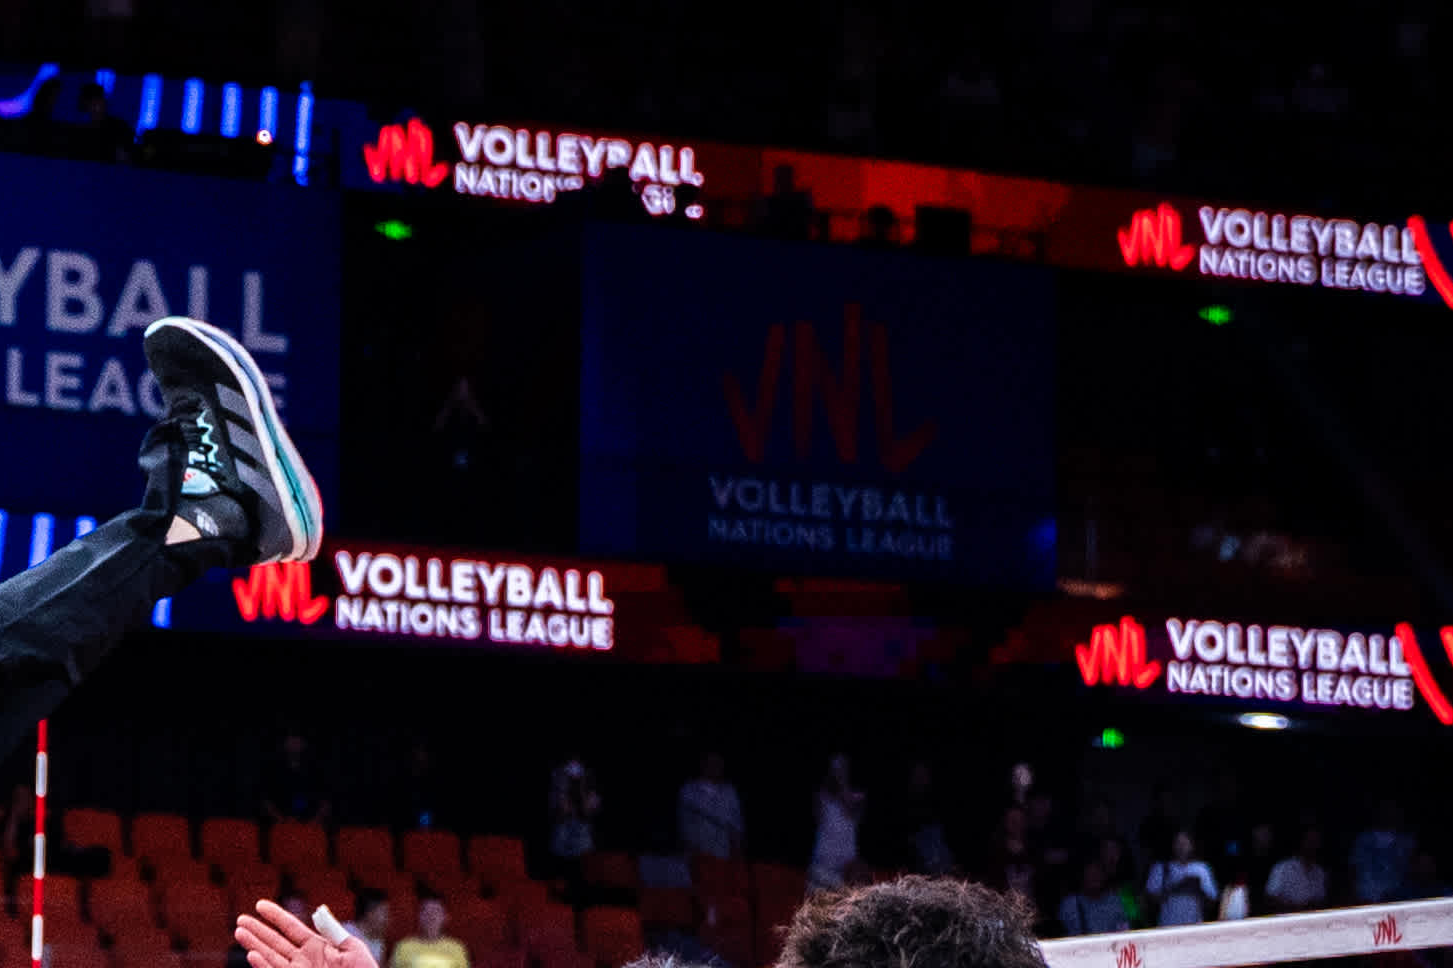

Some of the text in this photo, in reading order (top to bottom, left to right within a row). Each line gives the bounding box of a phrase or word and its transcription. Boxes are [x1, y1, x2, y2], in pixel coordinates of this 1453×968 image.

[454, 162, 583, 203] NATIO
[1199, 206, 1422, 264] VOLLEYBALL
[1199, 244, 1426, 295] NATIONS LEAGUE
[708, 476, 955, 528] VOLLEYBALL
[708, 517, 835, 552] NATIONS
[335, 551, 614, 615] VOLLEYBALL
[335, 596, 613, 649] NATIONS LEAGUE
[1166, 618, 1411, 676] VOLLEYBALL
[1167, 660, 1414, 710] NATIONS LEAGUE
